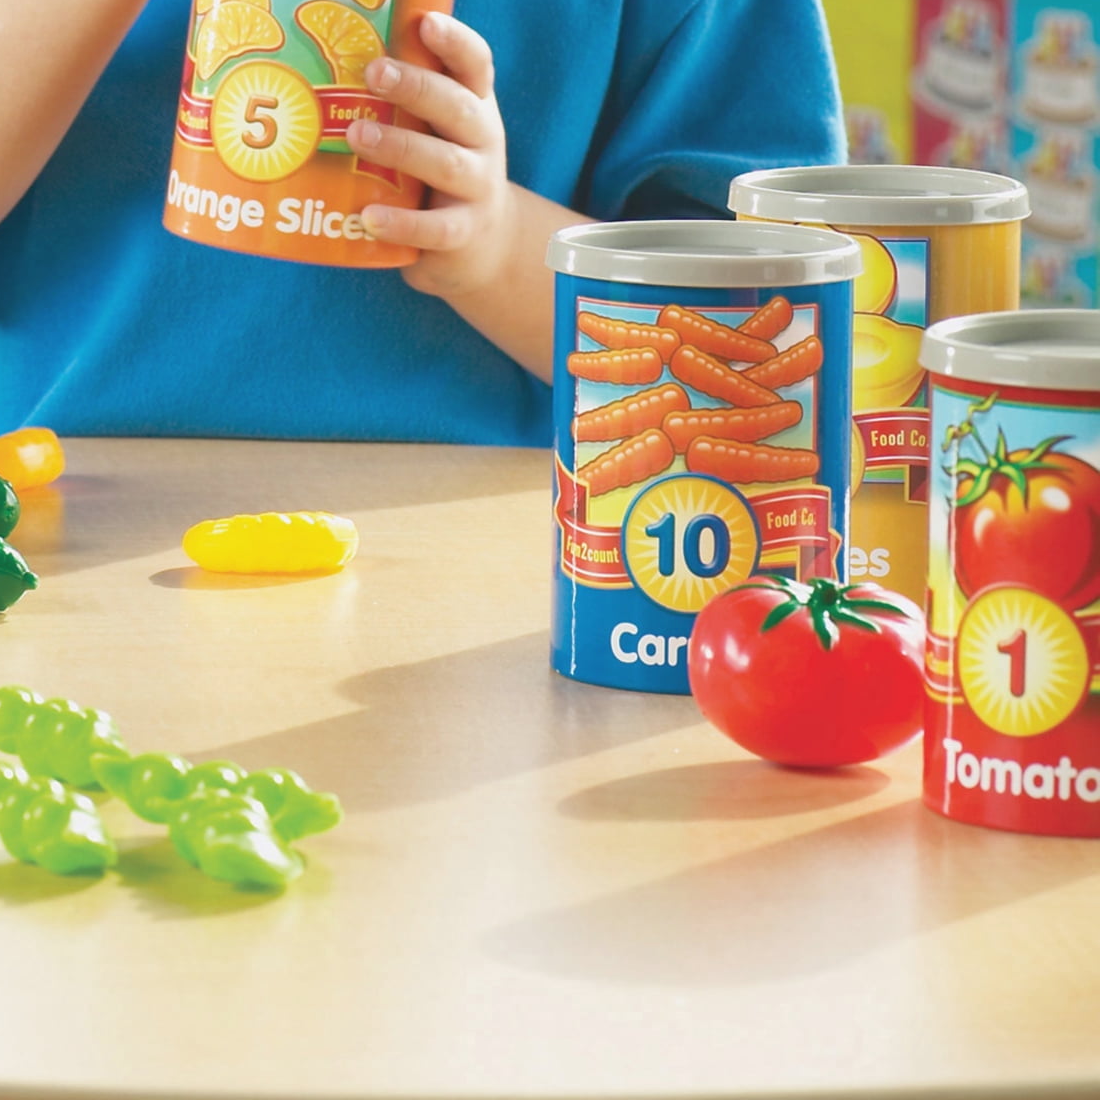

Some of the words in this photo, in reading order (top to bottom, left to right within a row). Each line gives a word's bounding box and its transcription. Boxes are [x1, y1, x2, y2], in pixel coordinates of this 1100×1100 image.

[242, 95, 278, 149] 5
[330, 104, 361, 120] Food
[167, 170, 264, 232] Orange
[276, 197, 377, 241] Slice
[870, 430, 905, 448] Food
[645, 512, 732, 578] 10
[766, 509, 797, 530] Food
[610, 622, 688, 667] Car
[997, 629, 1027, 698] 1
[942, 738, 1100, 803] Tomato
